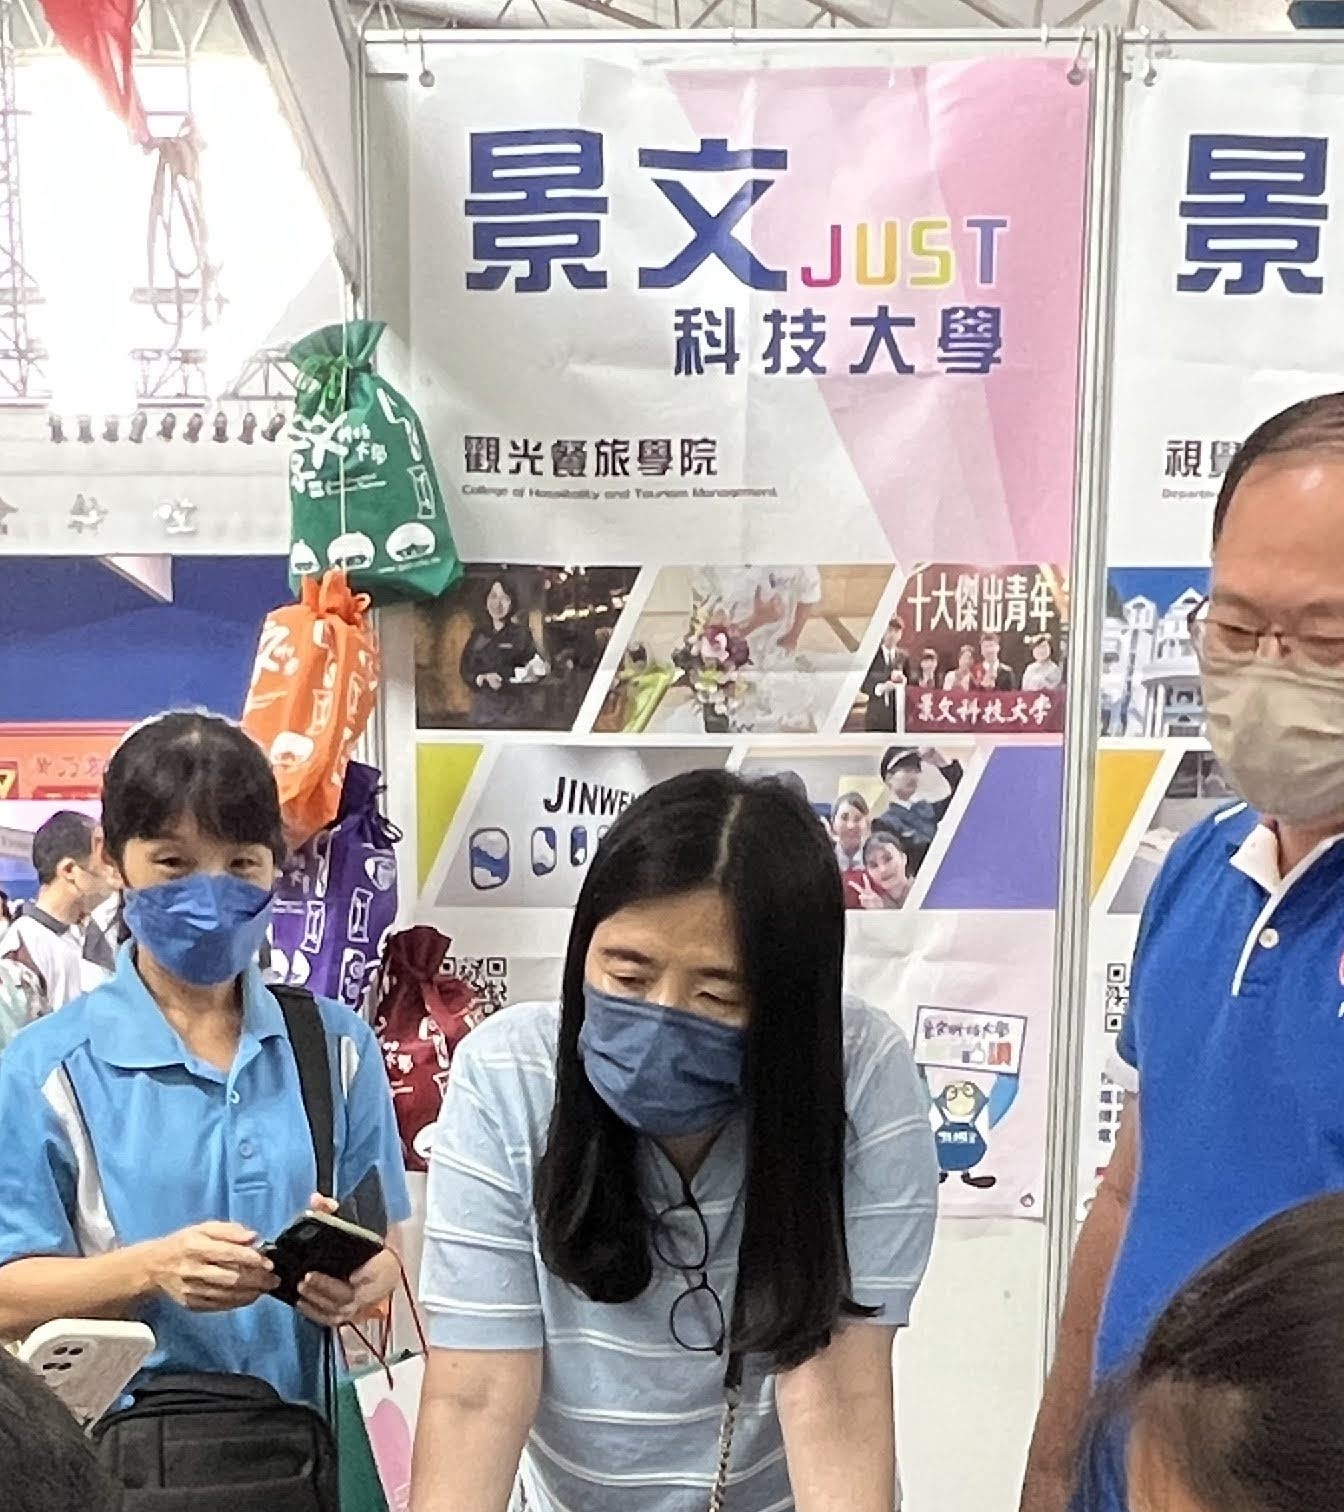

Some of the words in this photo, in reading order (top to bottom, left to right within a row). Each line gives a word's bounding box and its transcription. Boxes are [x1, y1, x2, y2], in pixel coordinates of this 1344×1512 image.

[464, 128, 788, 291] 景文
[801, 218, 1009, 288] JUST
[673, 306, 1002, 375] 科技大學
[464, 435, 718, 477] 觀光餐旅學院
